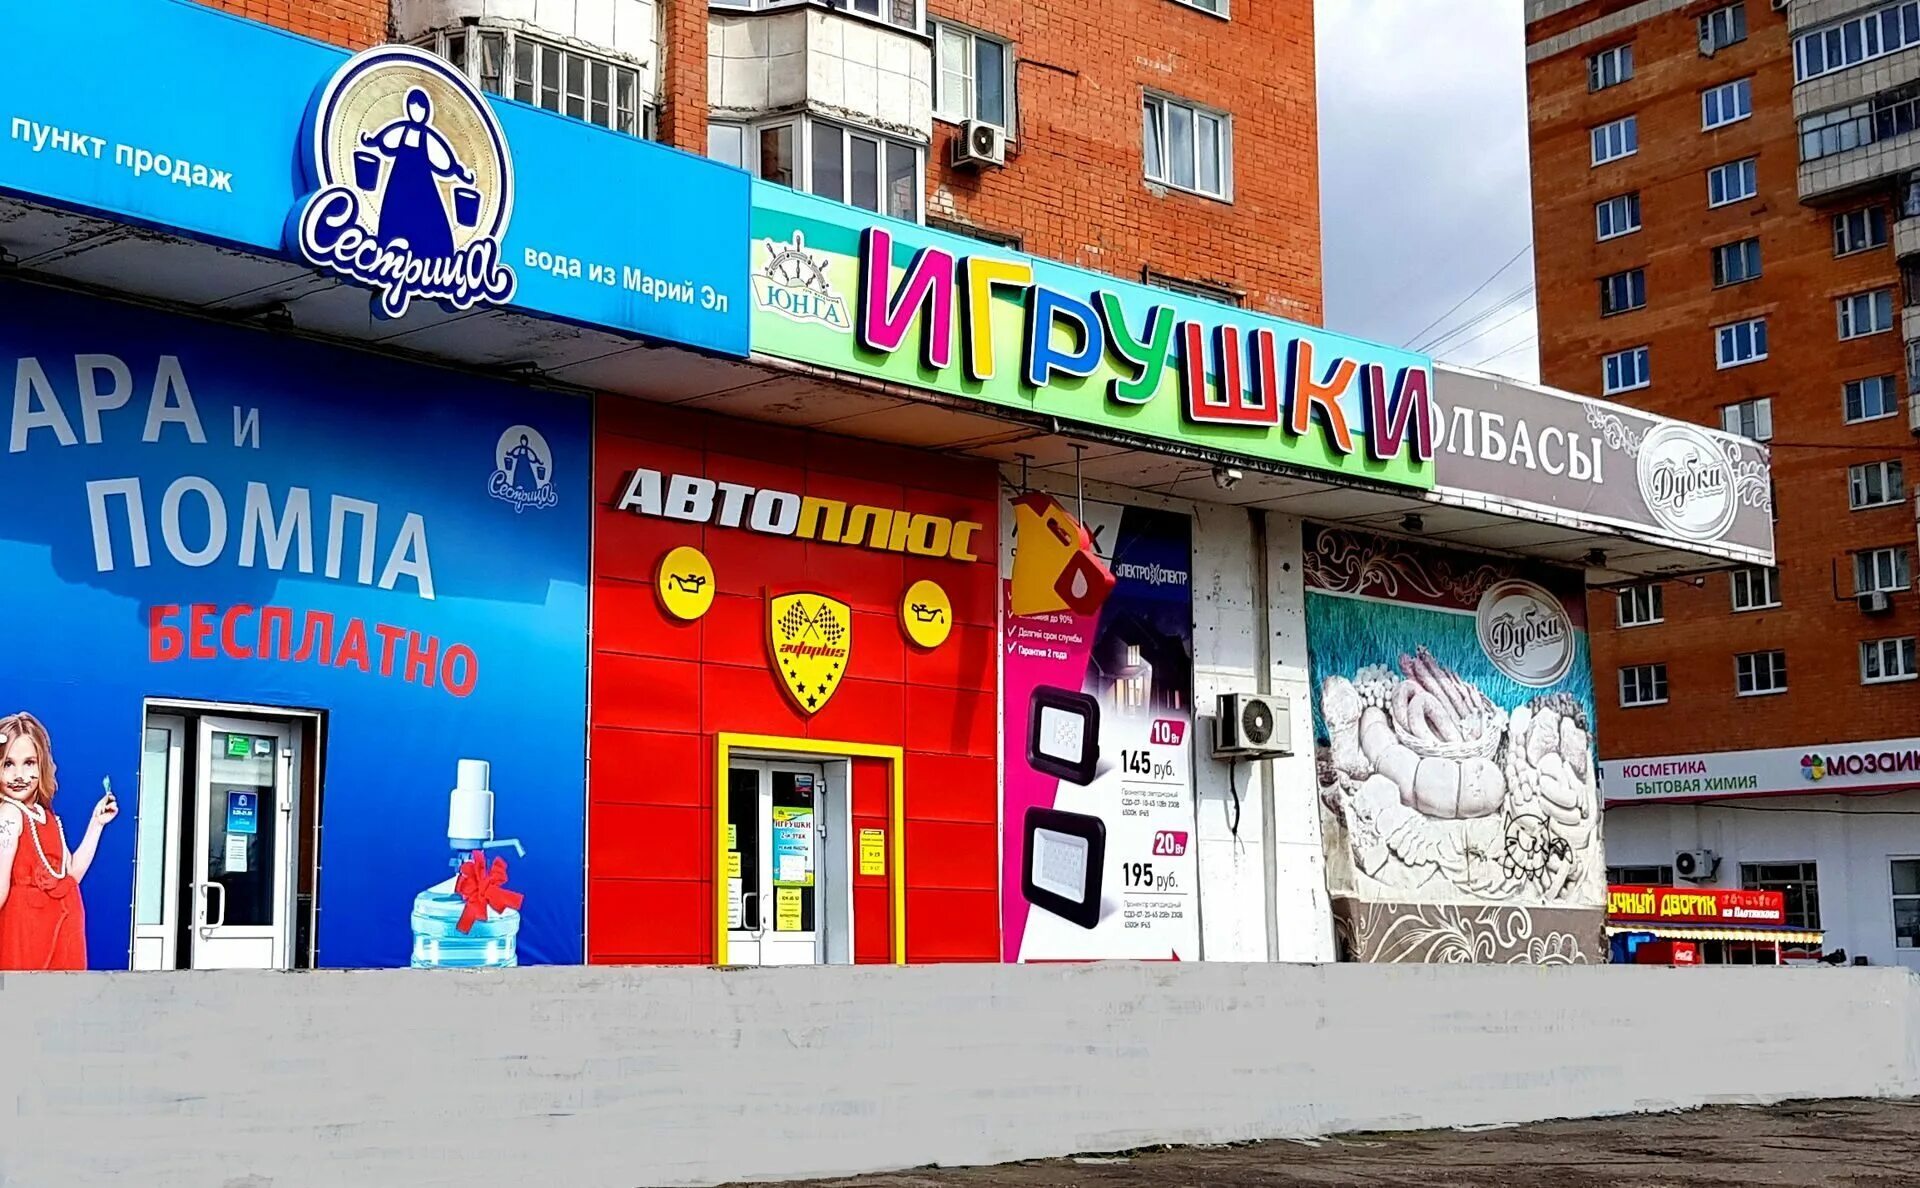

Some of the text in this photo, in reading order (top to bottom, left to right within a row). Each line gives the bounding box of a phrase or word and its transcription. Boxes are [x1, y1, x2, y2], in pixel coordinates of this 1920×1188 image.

[11, 116, 233, 193] пункт продаж
[301, 184, 517, 318] Сестрица
[524, 247, 729, 314] вода из Марий Эл
[767, 285, 841, 323] ЮНГА
[860, 226, 1433, 462] ИГРУШКИ
[9, 353, 207, 453] АРА
[489, 470, 558, 512] Сестрица
[1652, 454, 1723, 507] Дубки
[86, 475, 435, 600] ПОМПА
[618, 468, 983, 562] АВТОПЛЮС
[149, 603, 479, 698] БЕСПЛАТНО
[779, 641, 846, 661] autoplus
[1492, 610, 1562, 658] Дубки
[1153, 721, 1170, 742] 10
[1121, 750, 1176, 780] 145 руб.
[1623, 760, 1707, 779] КОСМЕТИКА
[1636, 775, 1758, 795] БЫТОВАЯ ХИМИЯ
[1155, 832, 1174, 854] 20
[1123, 862, 1179, 892] 195 руб.
[1660, 894, 1718, 917] ДВОРИК
